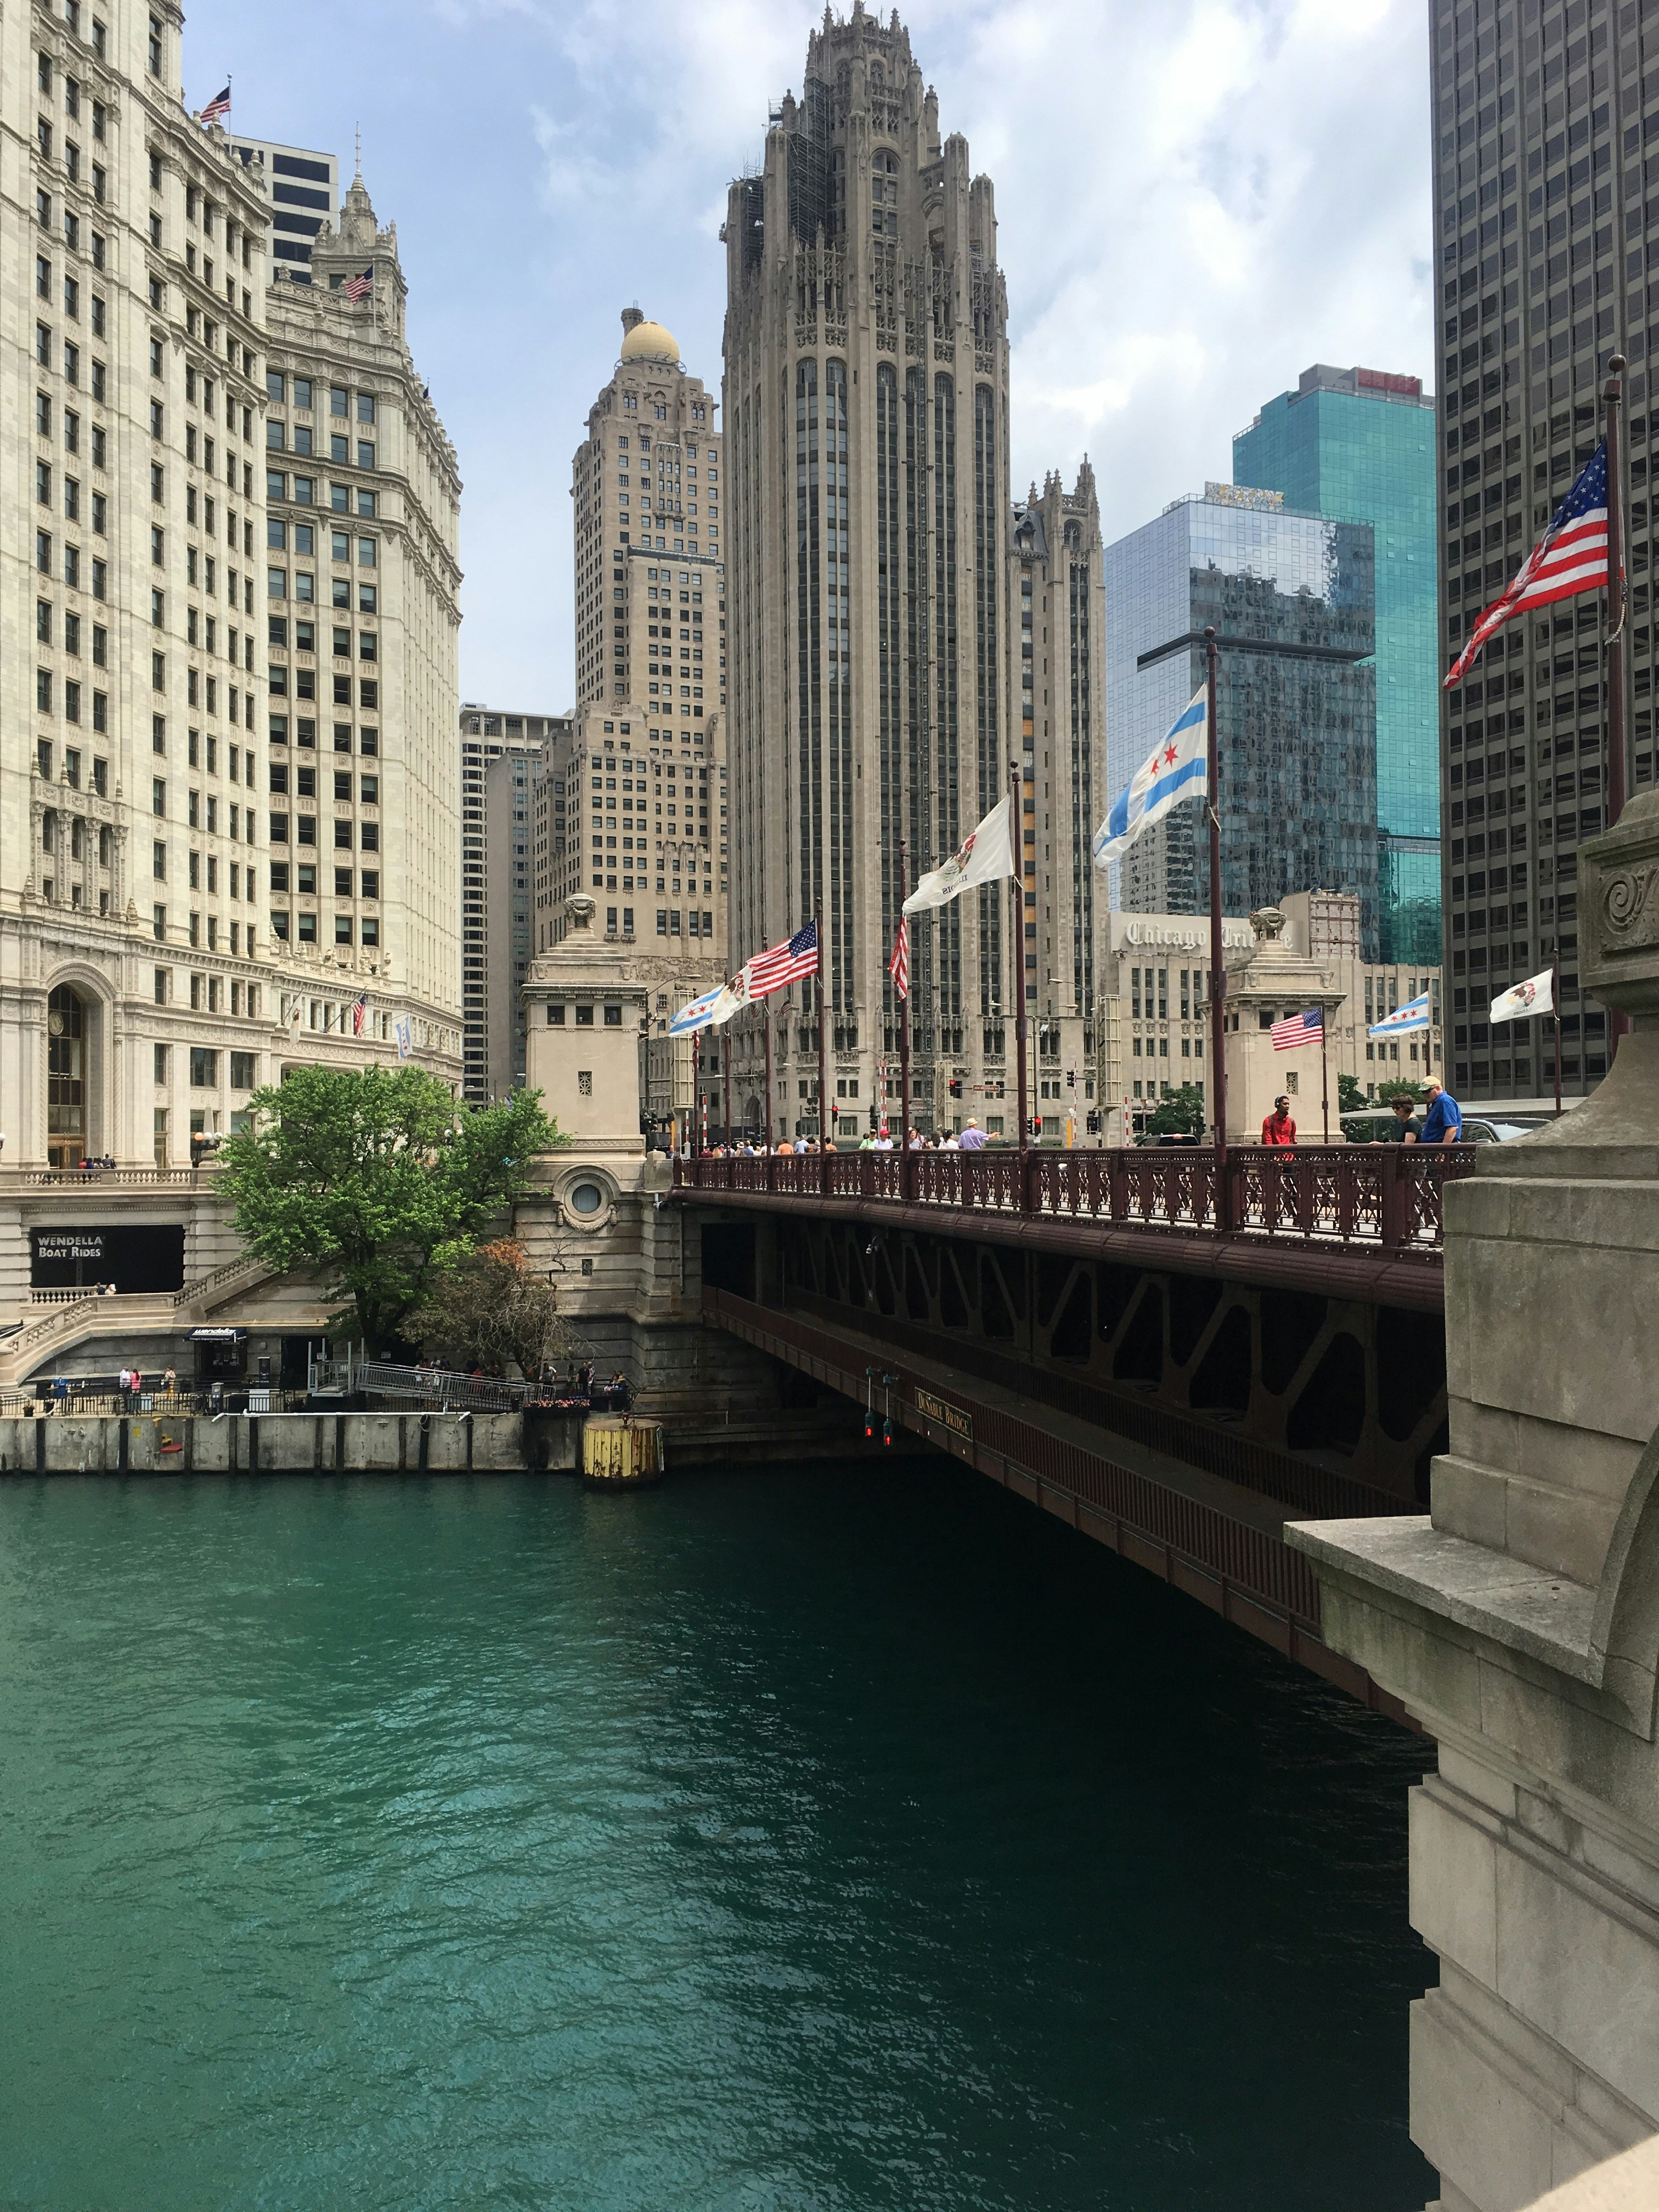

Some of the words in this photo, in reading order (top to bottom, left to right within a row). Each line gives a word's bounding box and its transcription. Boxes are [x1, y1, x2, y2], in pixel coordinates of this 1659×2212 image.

[1126, 920, 1207, 950] Chicago
[1221, 926, 1294, 950] Tribe
[37, 1236, 103, 1246] WENDELLA
[38, 1247, 67, 1257] BOAT
[71, 1246, 101, 1257] RIDES
[945, 1405, 969, 1435] BRIDGE
